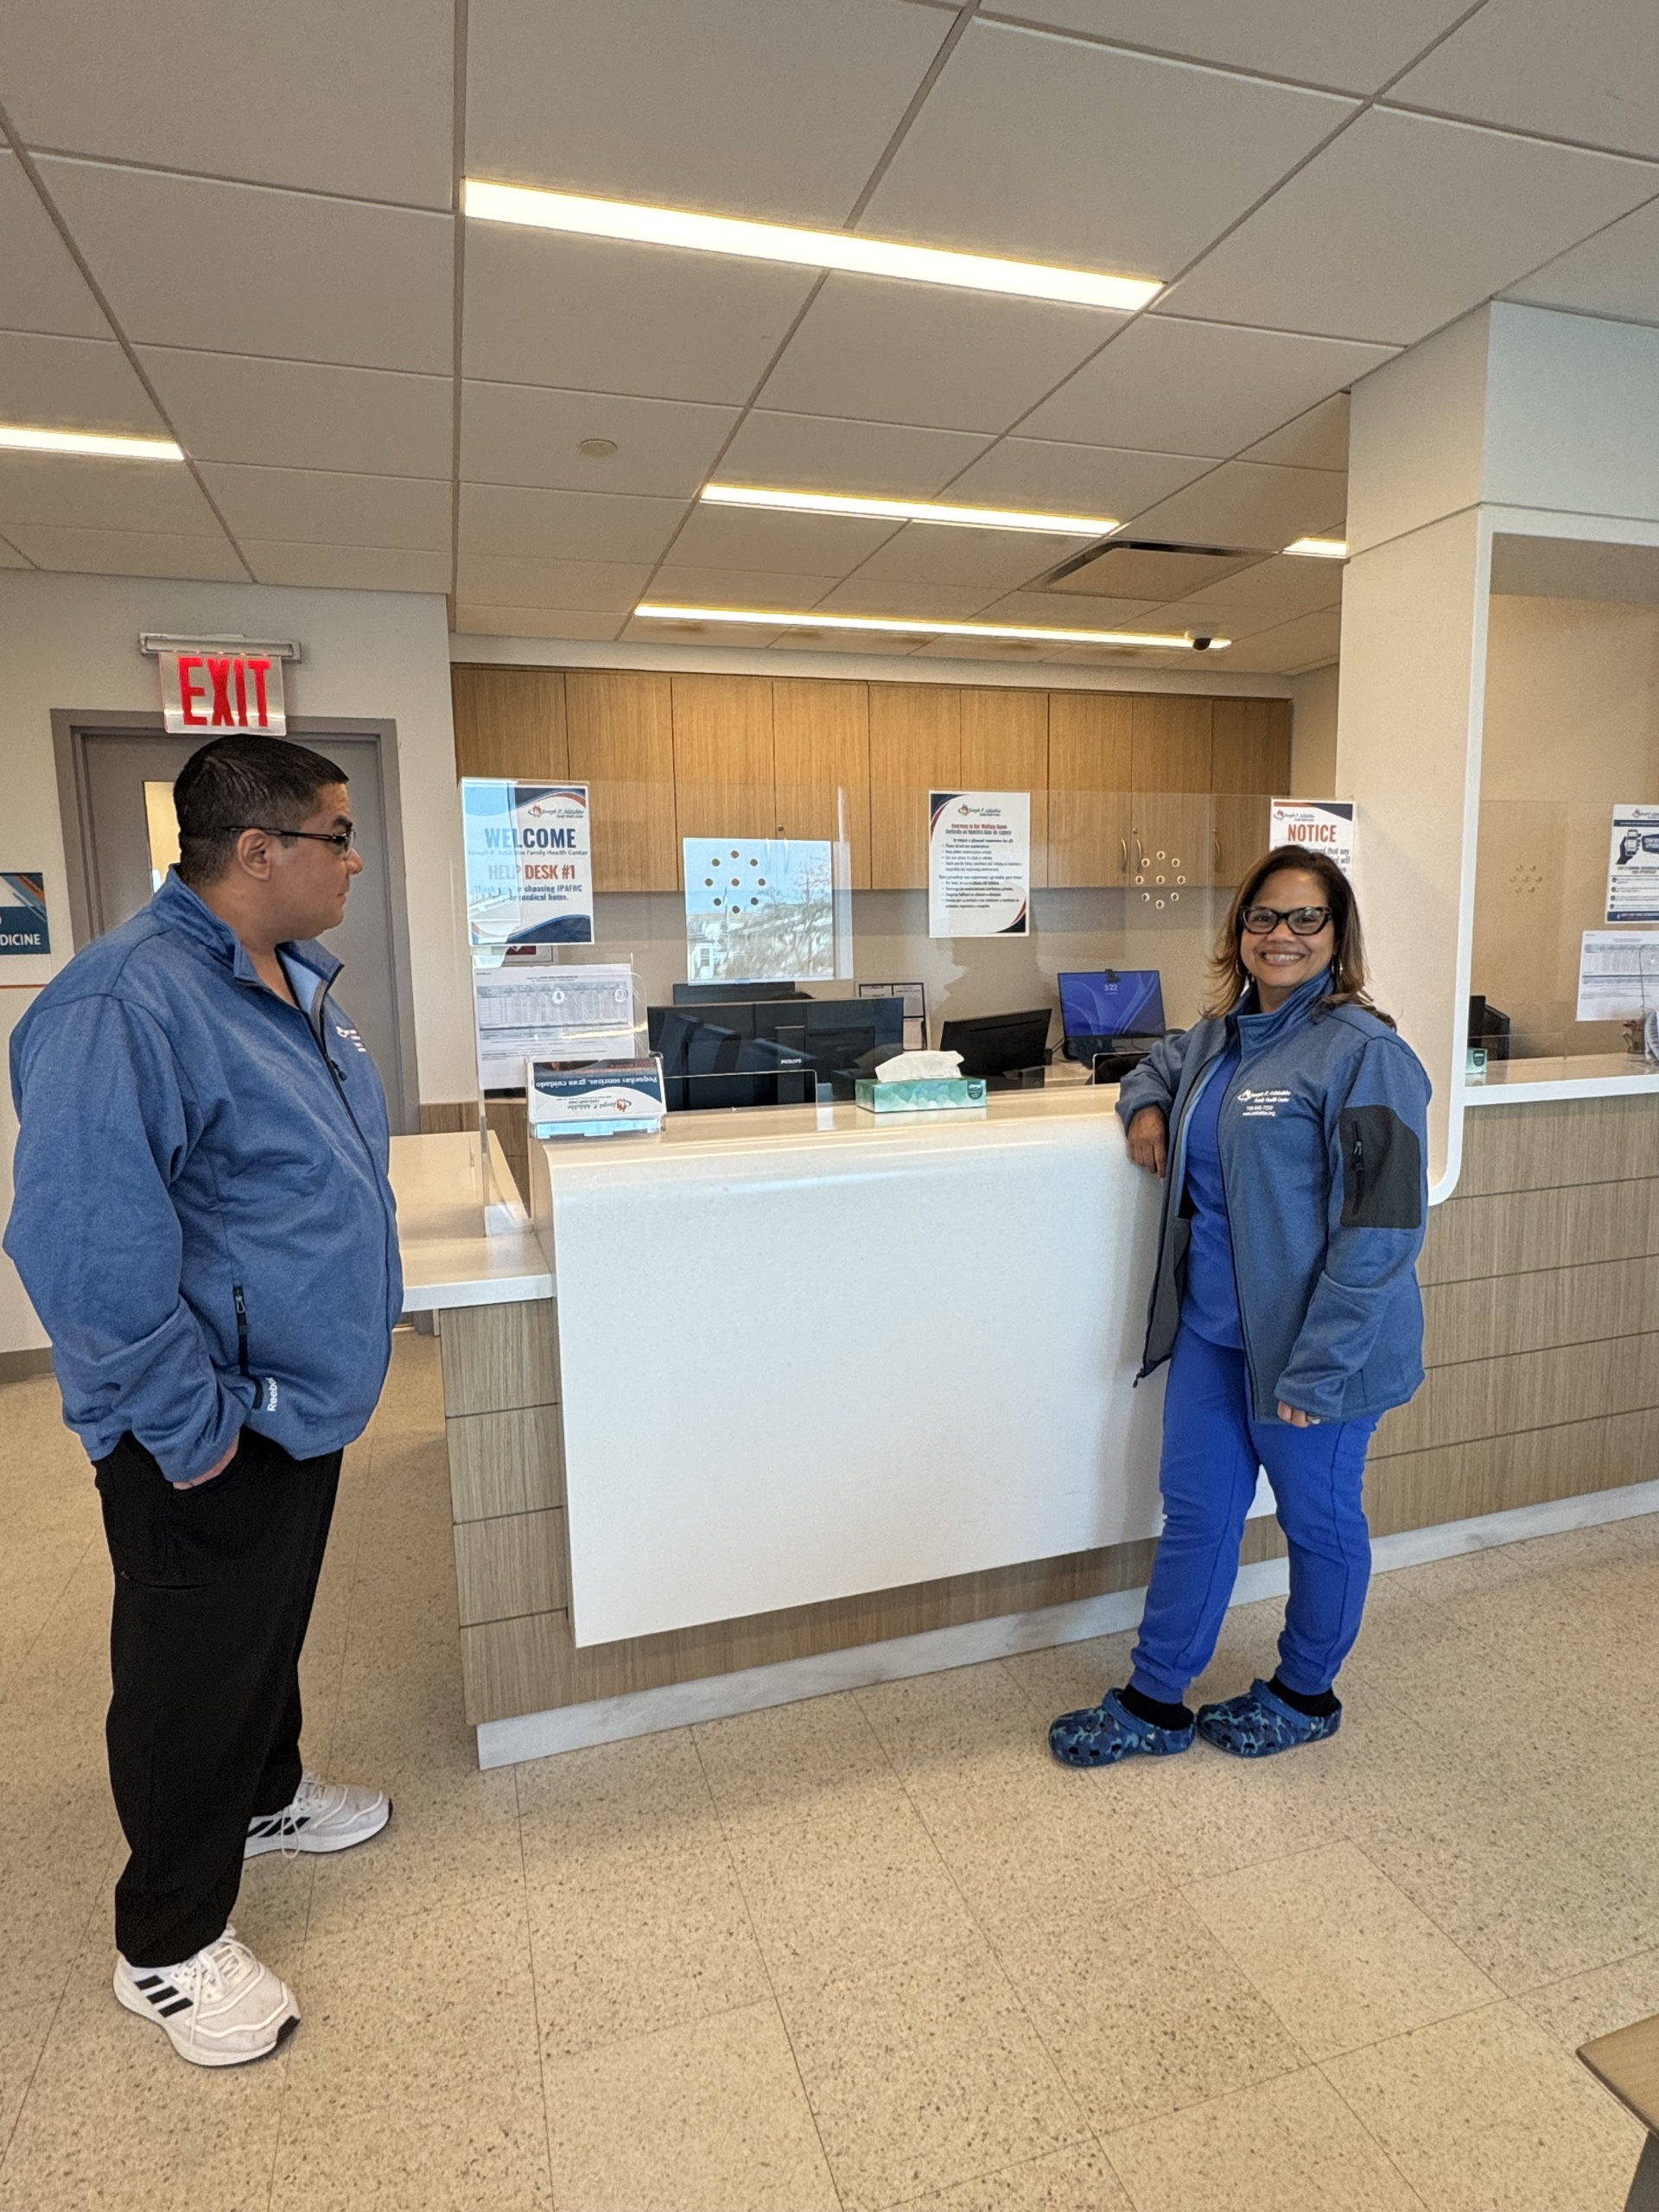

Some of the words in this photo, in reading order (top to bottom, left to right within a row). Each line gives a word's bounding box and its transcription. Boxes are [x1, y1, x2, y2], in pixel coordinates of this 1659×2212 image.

[177, 657, 270, 728] EXIT
[485, 828, 576, 848] WELCOME
[1287, 823, 1337, 842] NOTICE
[488, 865, 521, 880] HELP
[524, 865, 558, 880] DESK
[562, 865, 575, 880] #1
[524, 885, 555, 893] choosing
